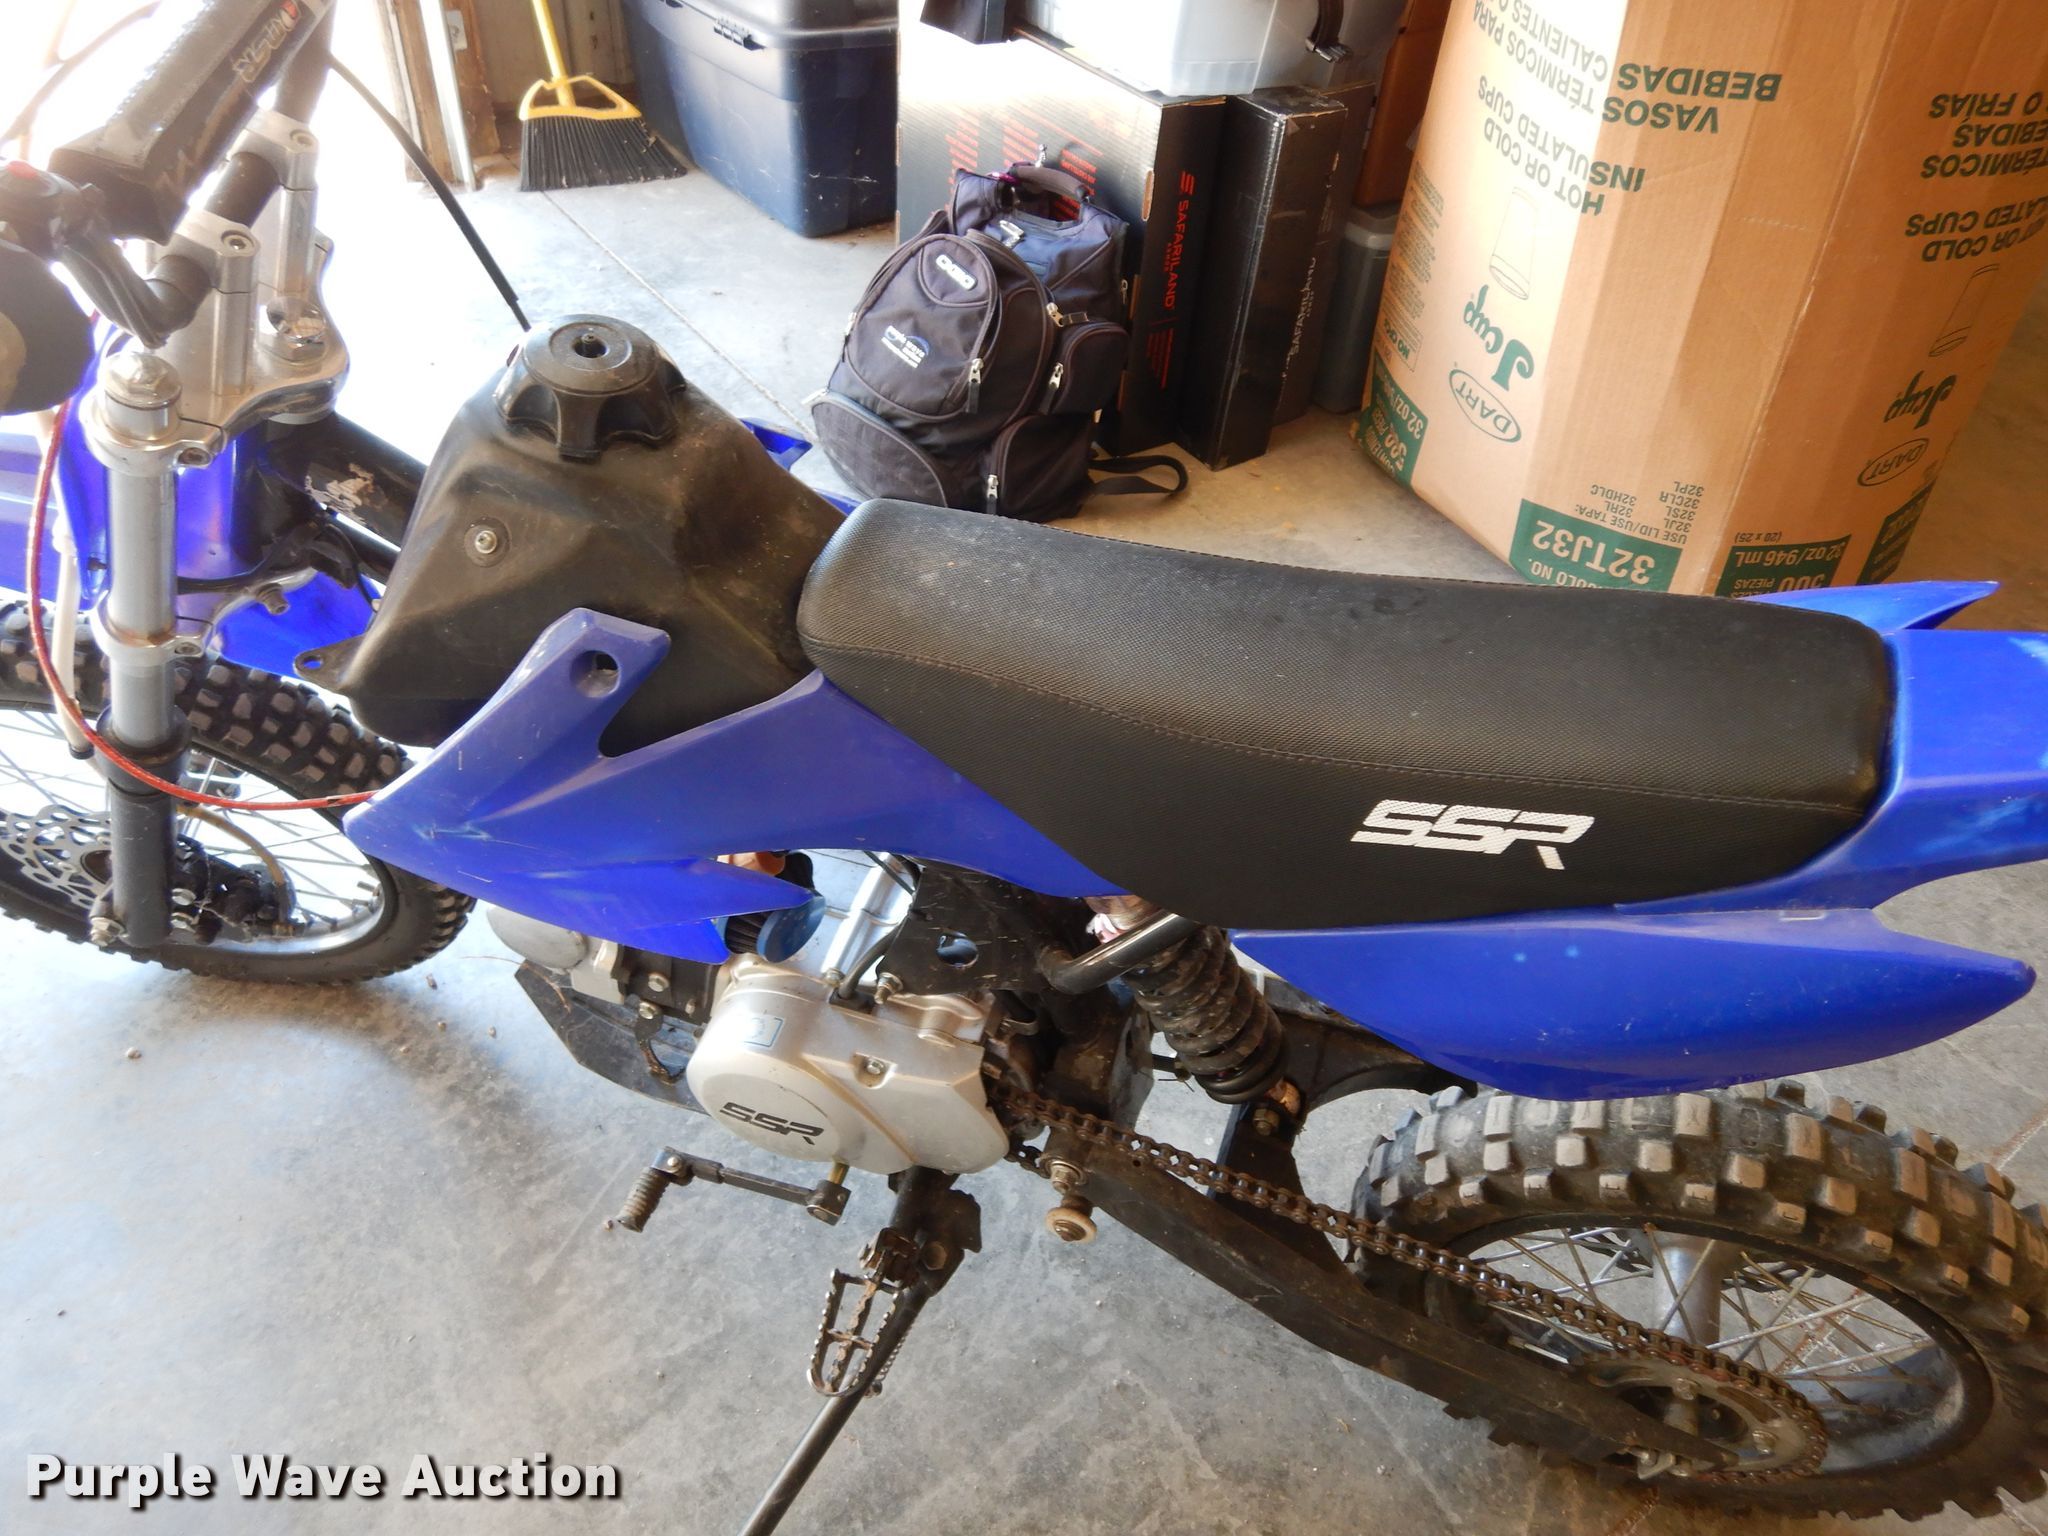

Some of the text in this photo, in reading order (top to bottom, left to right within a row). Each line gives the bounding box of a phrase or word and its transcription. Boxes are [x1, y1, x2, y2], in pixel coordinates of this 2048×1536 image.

[1512, 0, 1608, 82] CALIENTES
[1473, 0, 1720, 134] VASOS TÉRMICOS PARA
[1617, 62, 1782, 102] BEBIDAS
[1477, 75, 1514, 125] CUPS
[1928, 93, 2018, 122] FRÍAS
[1483, 117, 1605, 216] HOT OR COLD
[1517, 113, 1646, 192] INSULATED
[1904, 211, 1979, 237] CUPS
[1991, 228, 2020, 253] OR
[1162, 199, 1189, 308] SAFARILAND
[1921, 236, 1988, 262] COLD
[1408, 412, 1423, 439] 32
[1455, 381, 1512, 434] DART
[1865, 445, 1924, 481] DART
[1589, 484, 1700, 509] 32CLR 32HDLC
[1673, 481, 1704, 497] 32PL
[1573, 504, 1688, 544] USE LID/USE TAPA:
[1604, 500, 1696, 521] 32SL 32RL
[1663, 517, 1692, 533] 32JL
[1528, 558, 1553, 580] NO.
[1531, 519, 1655, 585] 32TJ32
[1735, 551, 1763, 567] mL
[1734, 578, 1775, 589] PIEZAS
[1350, 799, 1595, 870] SSR
[720, 1102, 824, 1146] SSR
